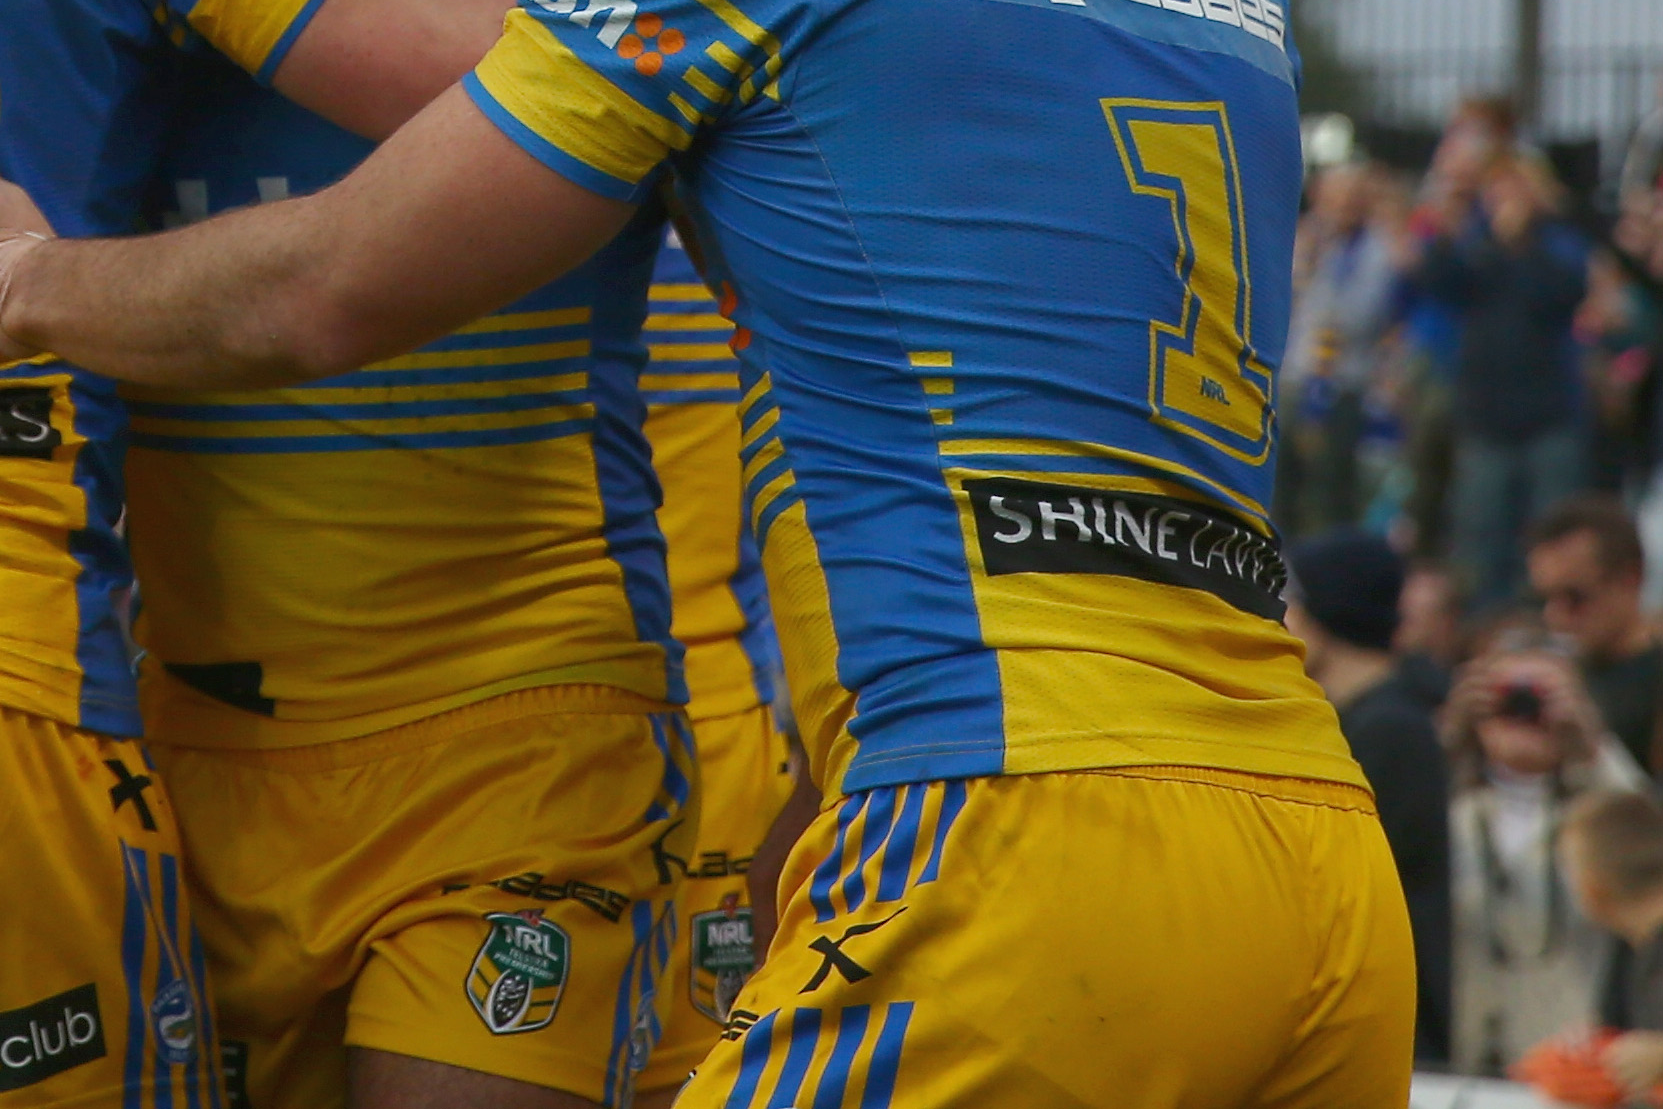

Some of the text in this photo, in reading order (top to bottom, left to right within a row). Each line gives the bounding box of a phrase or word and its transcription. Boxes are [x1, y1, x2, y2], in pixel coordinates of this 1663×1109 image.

[1098, 98, 1276, 467] 1
[989, 495, 1191, 561] SHINE
[503, 924, 559, 962] NRL
[707, 921, 754, 946] NRL
